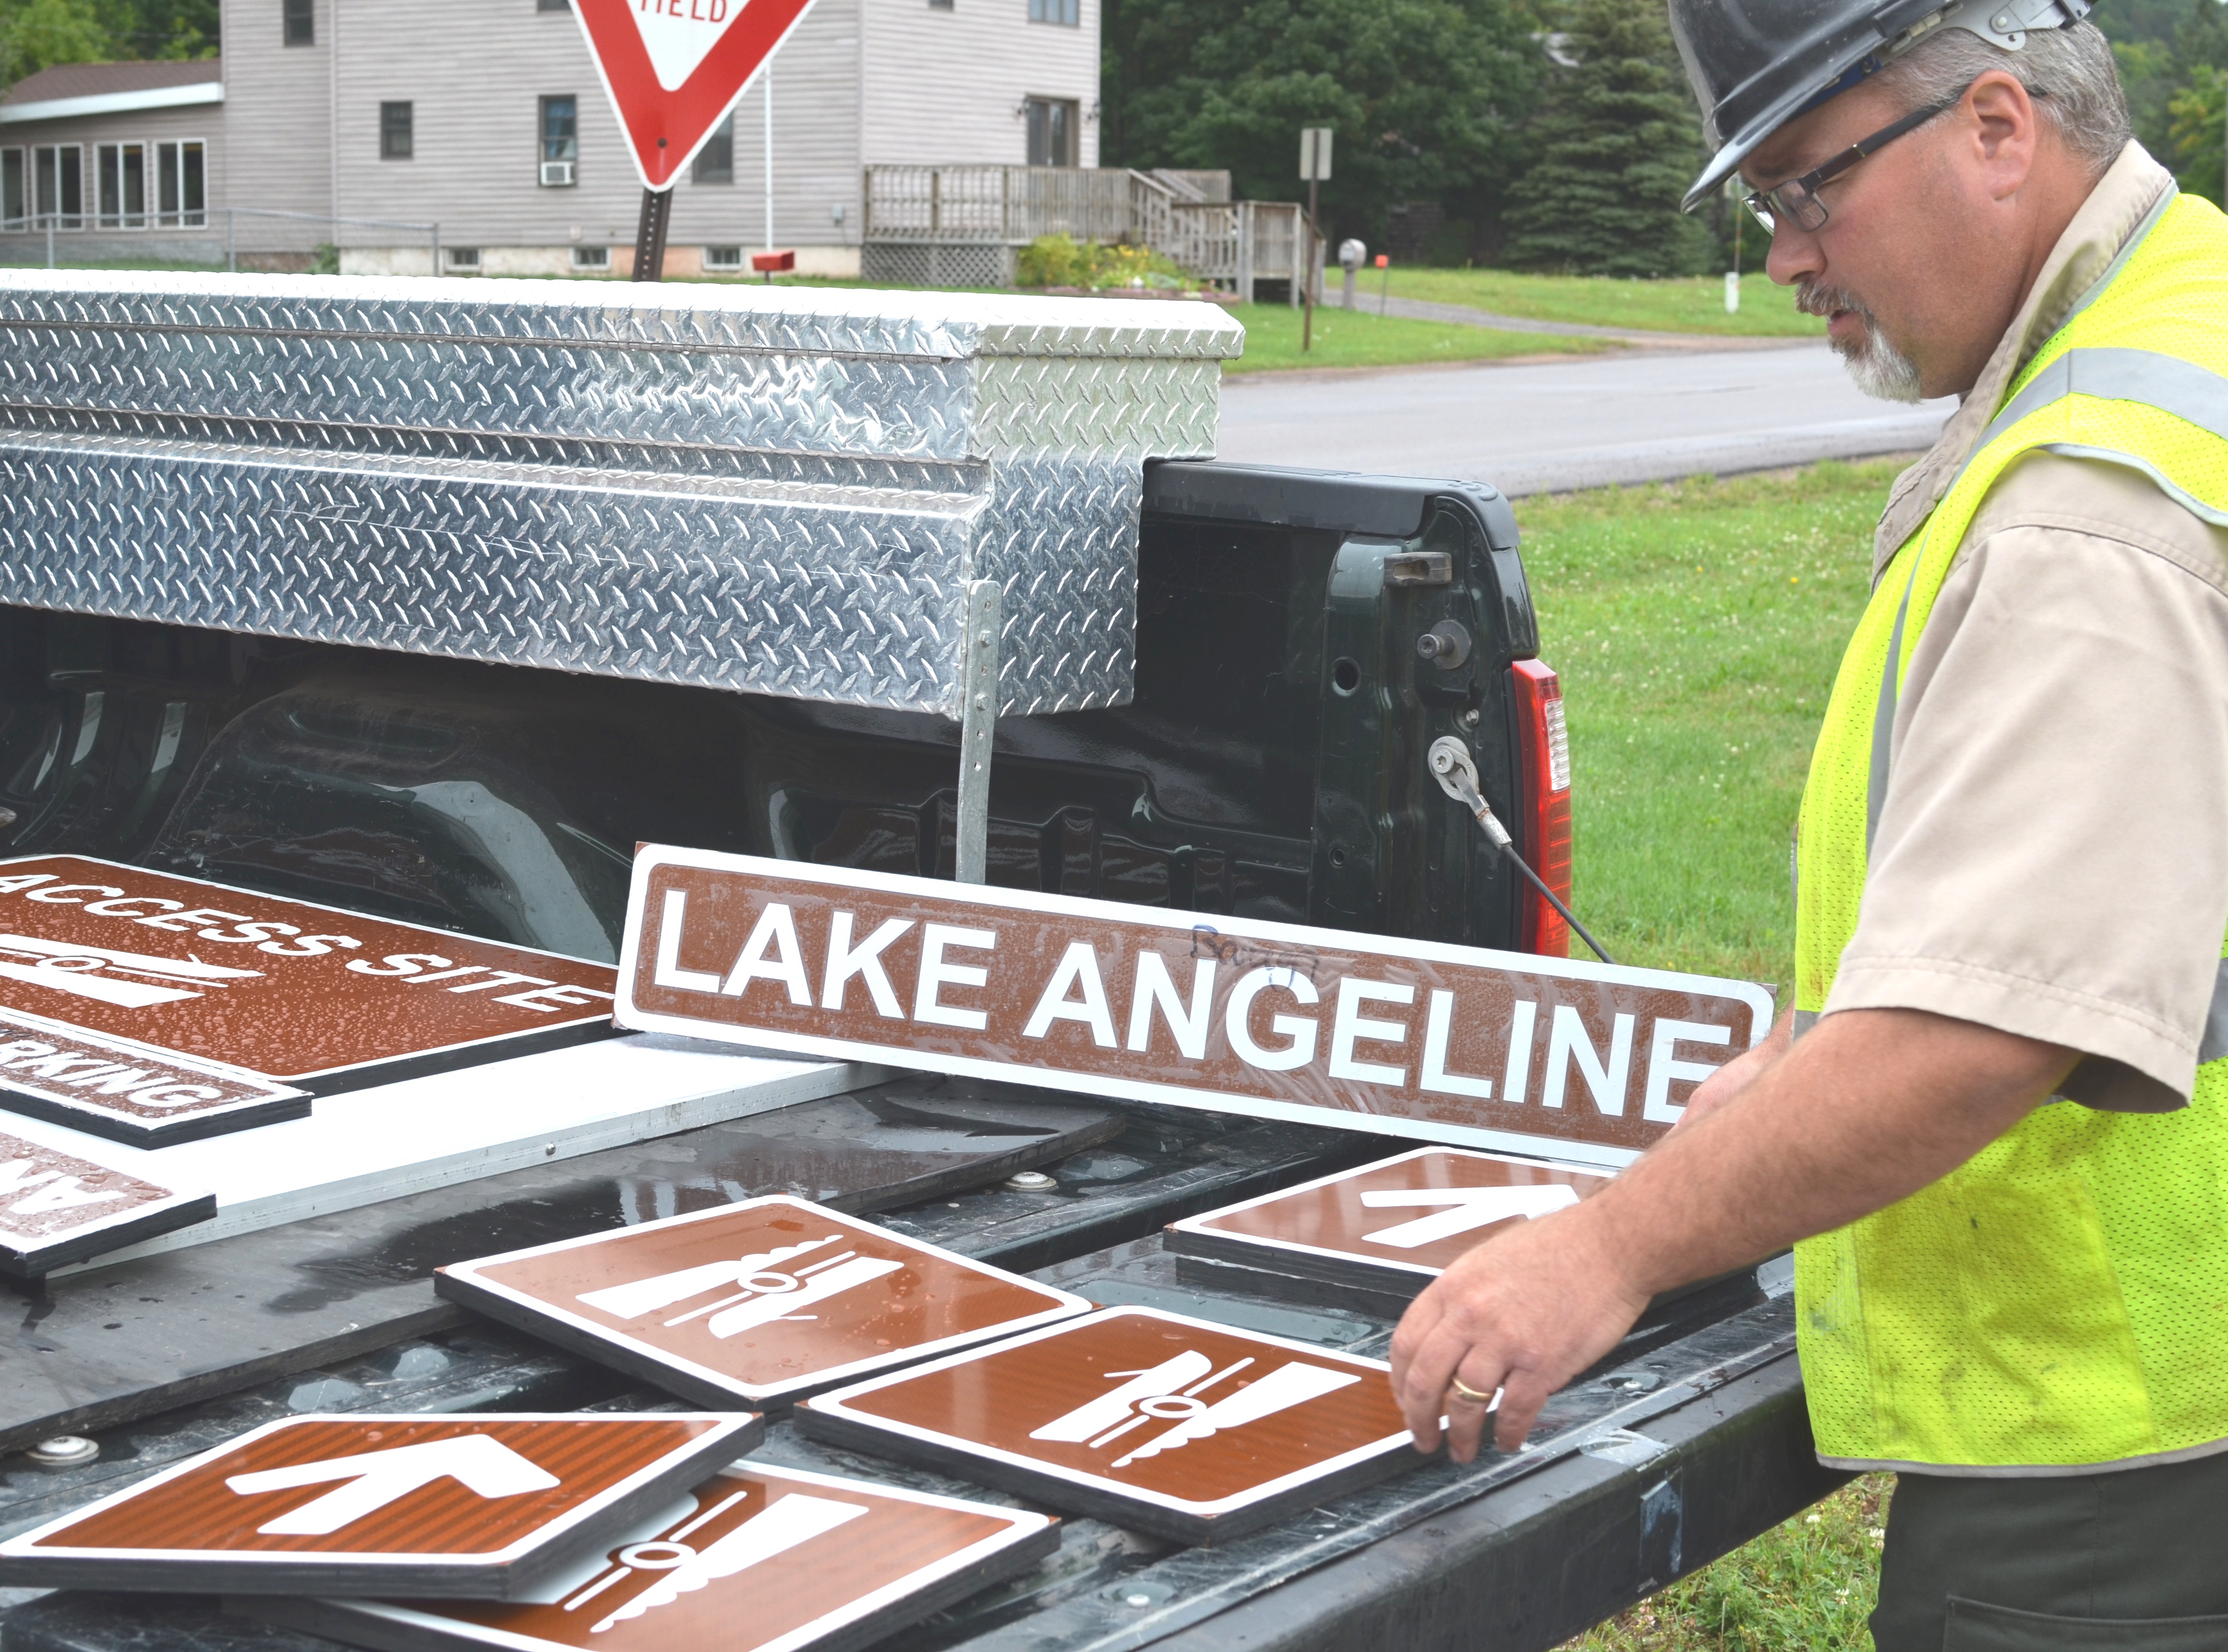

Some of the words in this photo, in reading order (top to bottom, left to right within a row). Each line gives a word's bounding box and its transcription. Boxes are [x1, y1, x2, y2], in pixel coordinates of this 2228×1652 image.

[0, 874, 362, 956] ACCESS
[346, 953, 615, 1012] SITE
[654, 889, 997, 1030] LAKE
[1022, 941, 1732, 1123] ANGELINE
[0, 1029, 222, 1107] RKING
